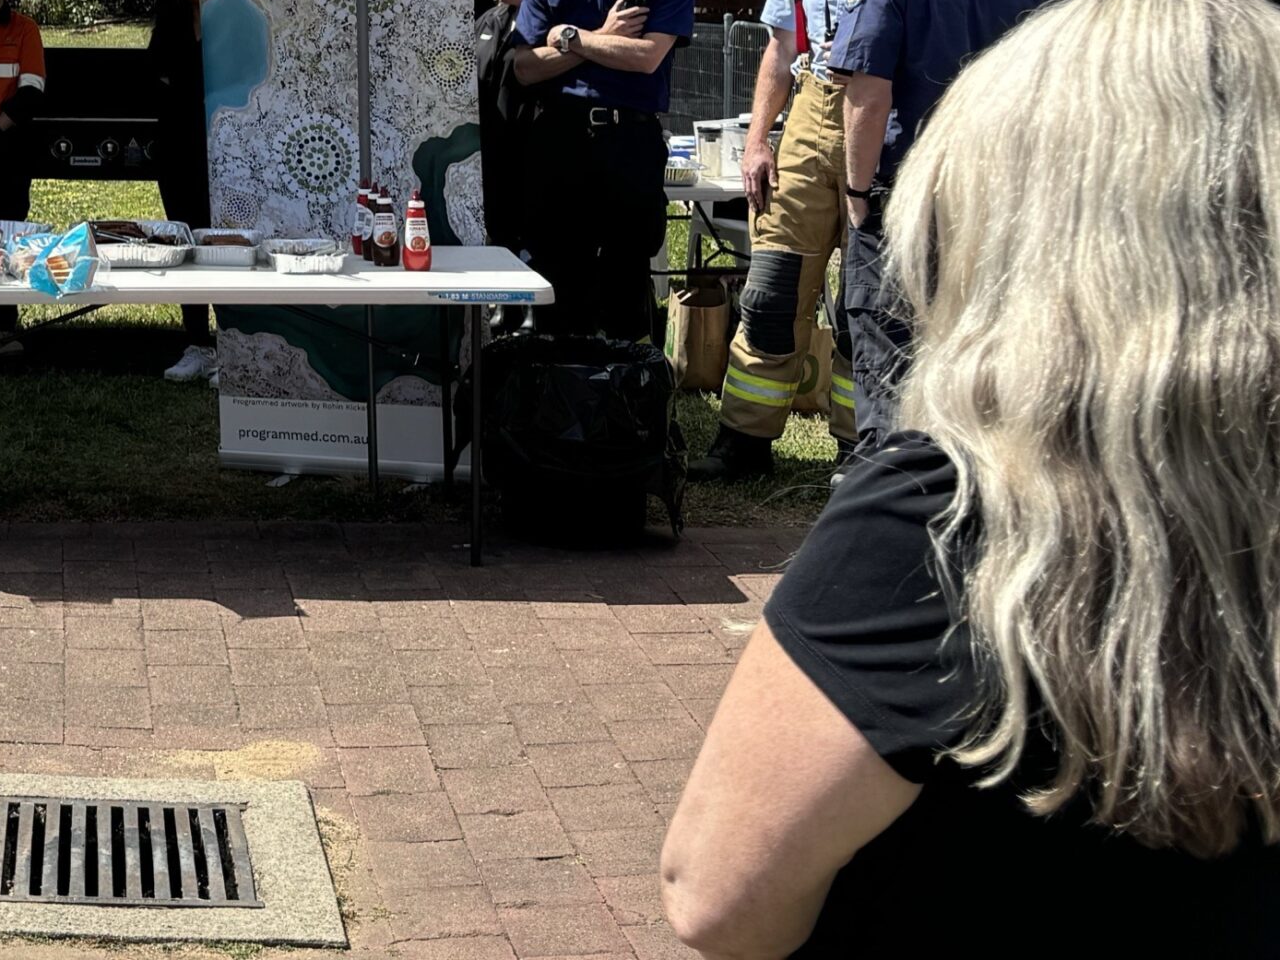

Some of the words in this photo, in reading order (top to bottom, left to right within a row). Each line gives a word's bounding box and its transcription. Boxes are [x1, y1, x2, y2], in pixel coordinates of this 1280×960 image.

[232, 398, 278, 407] Programmed
[280, 400, 309, 408] artwork
[311, 402, 321, 411] by
[238, 428, 369, 445] programmed.com.au
